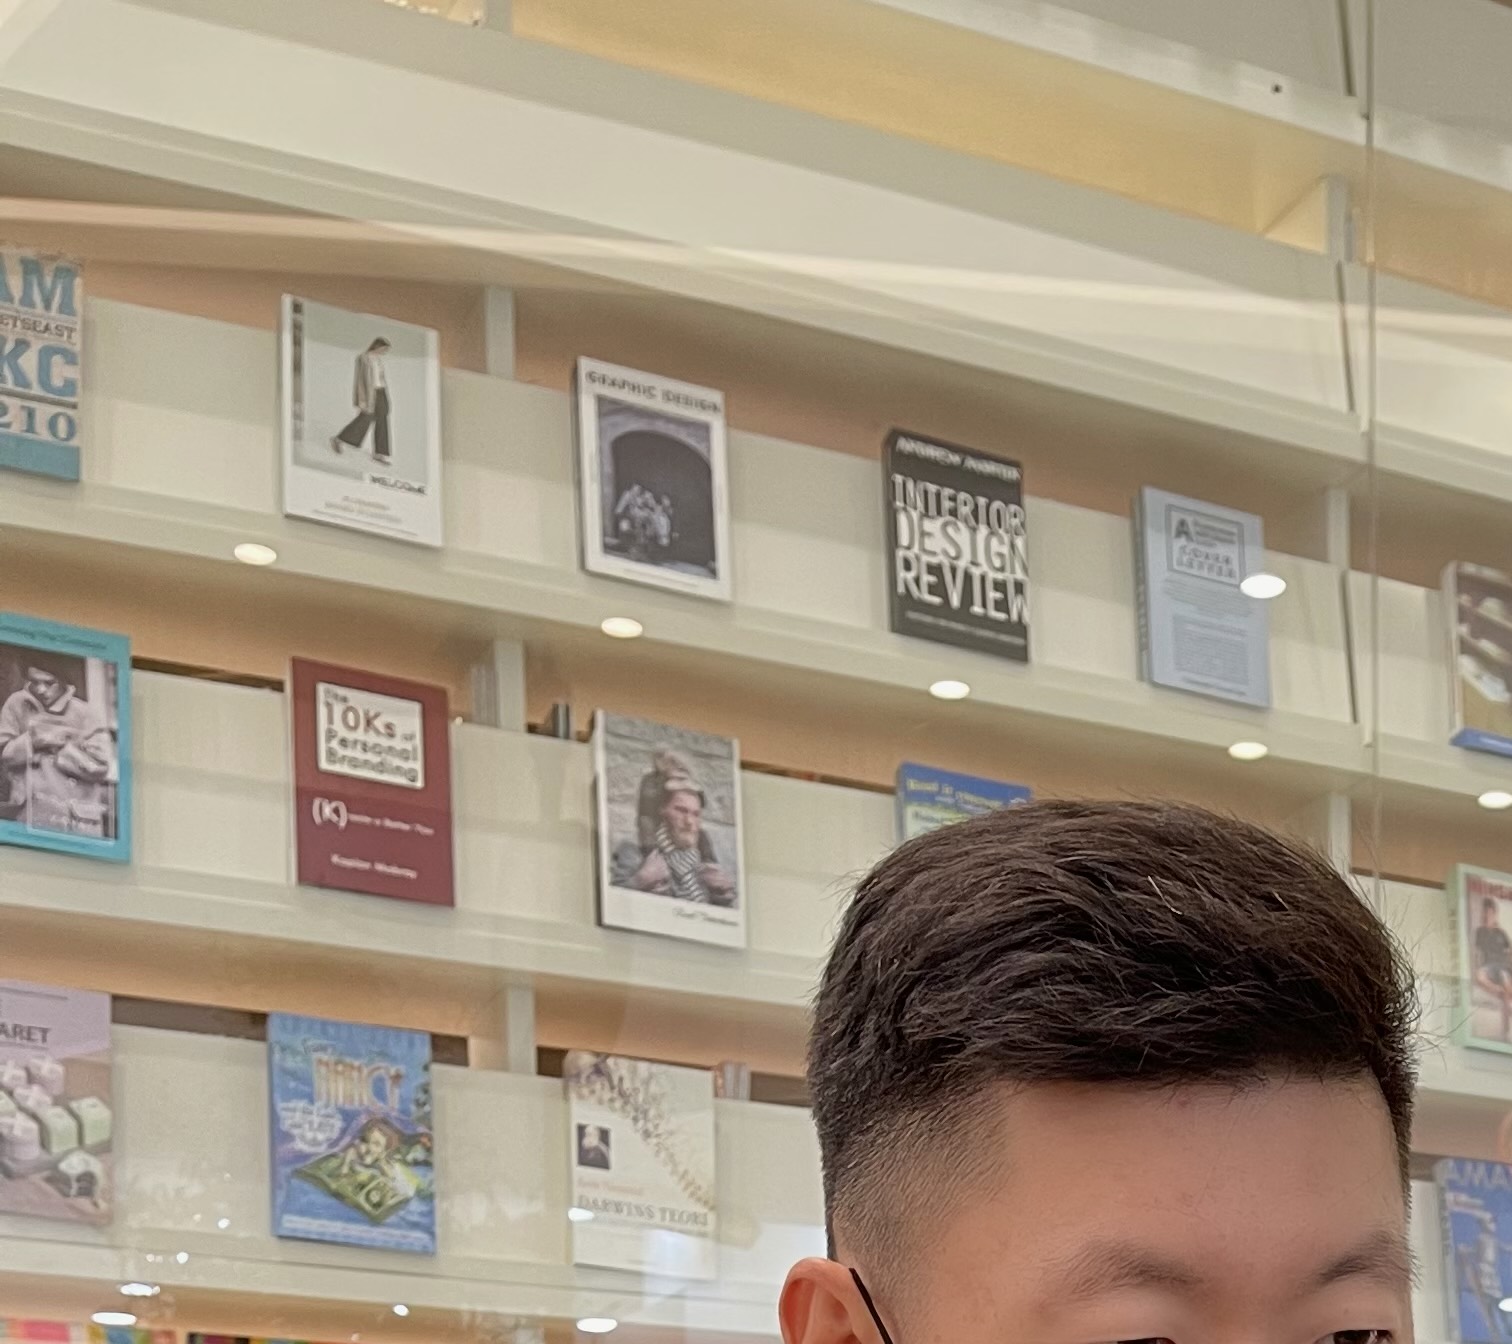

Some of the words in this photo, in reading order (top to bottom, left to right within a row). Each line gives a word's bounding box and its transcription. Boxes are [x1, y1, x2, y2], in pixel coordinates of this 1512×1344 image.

[892, 472, 1026, 538] INTERIOR
[897, 506, 1029, 578] DESIGN
[896, 548, 1030, 625] REVIEW
[325, 700, 396, 739] 10Ks
[325, 727, 418, 762] Personal
[325, 746, 418, 783] Branding
